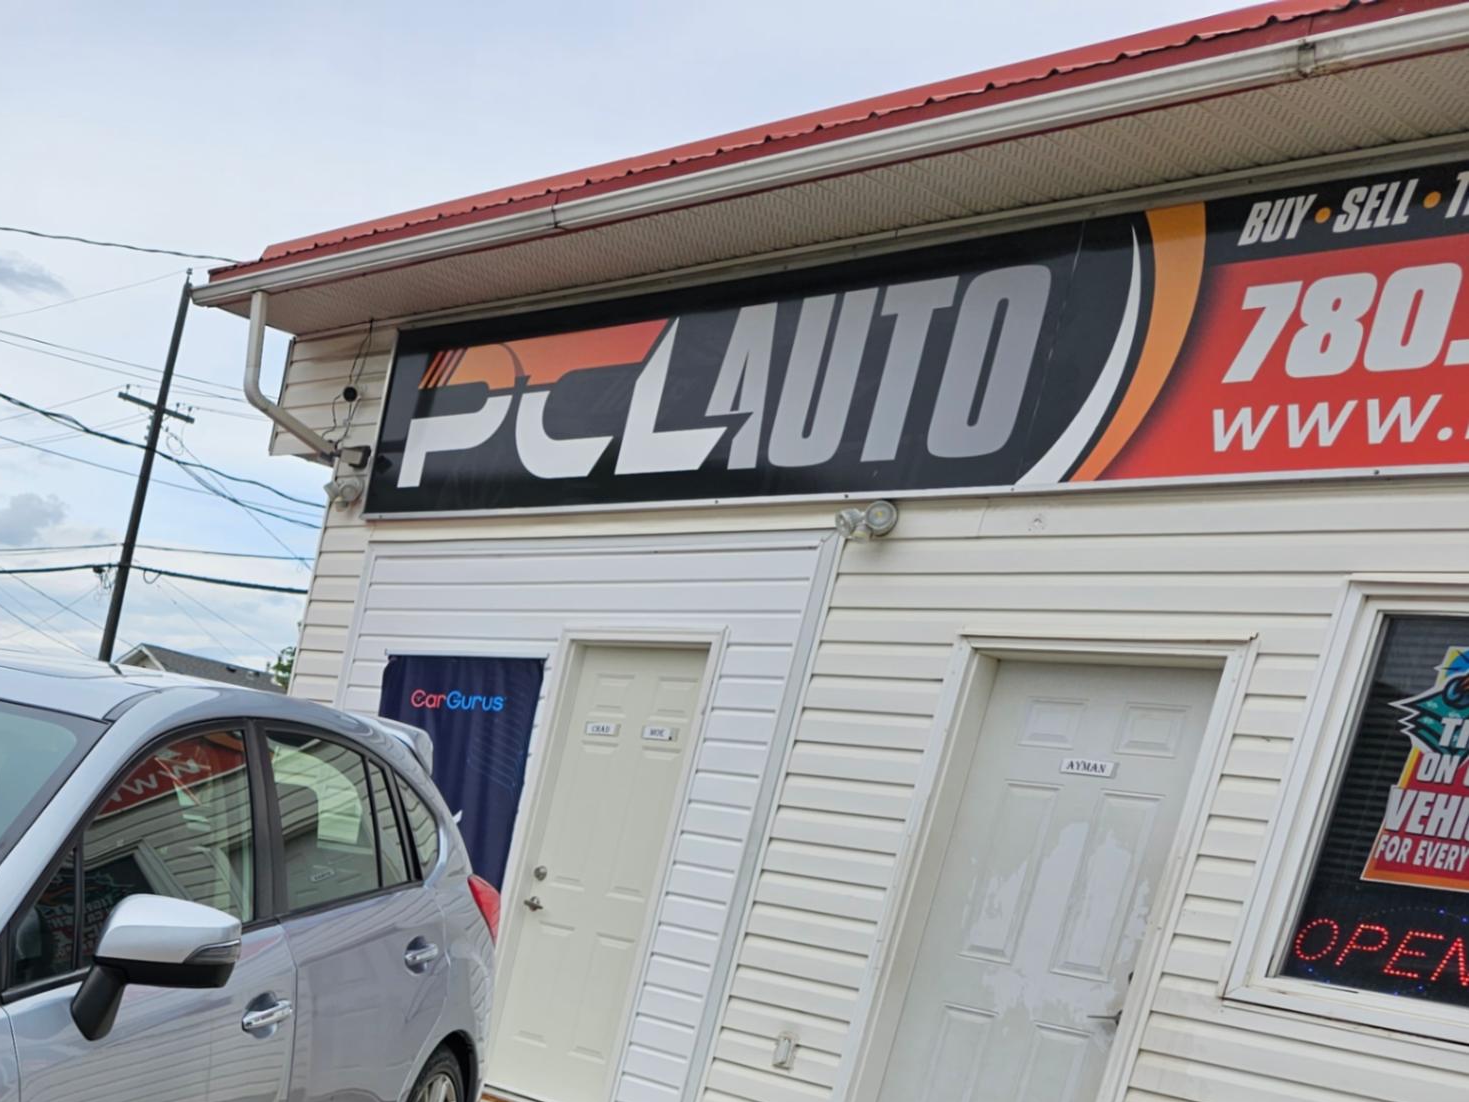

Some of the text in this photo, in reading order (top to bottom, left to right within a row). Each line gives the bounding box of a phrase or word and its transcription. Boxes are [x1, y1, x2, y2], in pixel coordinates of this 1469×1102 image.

[1237, 170, 1469, 246] BUY SELL T
[705, 264, 1052, 470] AUTO
[411, 689, 504, 711] CarGurus
[1066, 760, 1107, 774] AYMAN
[1416, 752, 1460, 784] ON
[1385, 786, 1469, 841] VEHI
[1375, 834, 1469, 872] FOR EVERY
